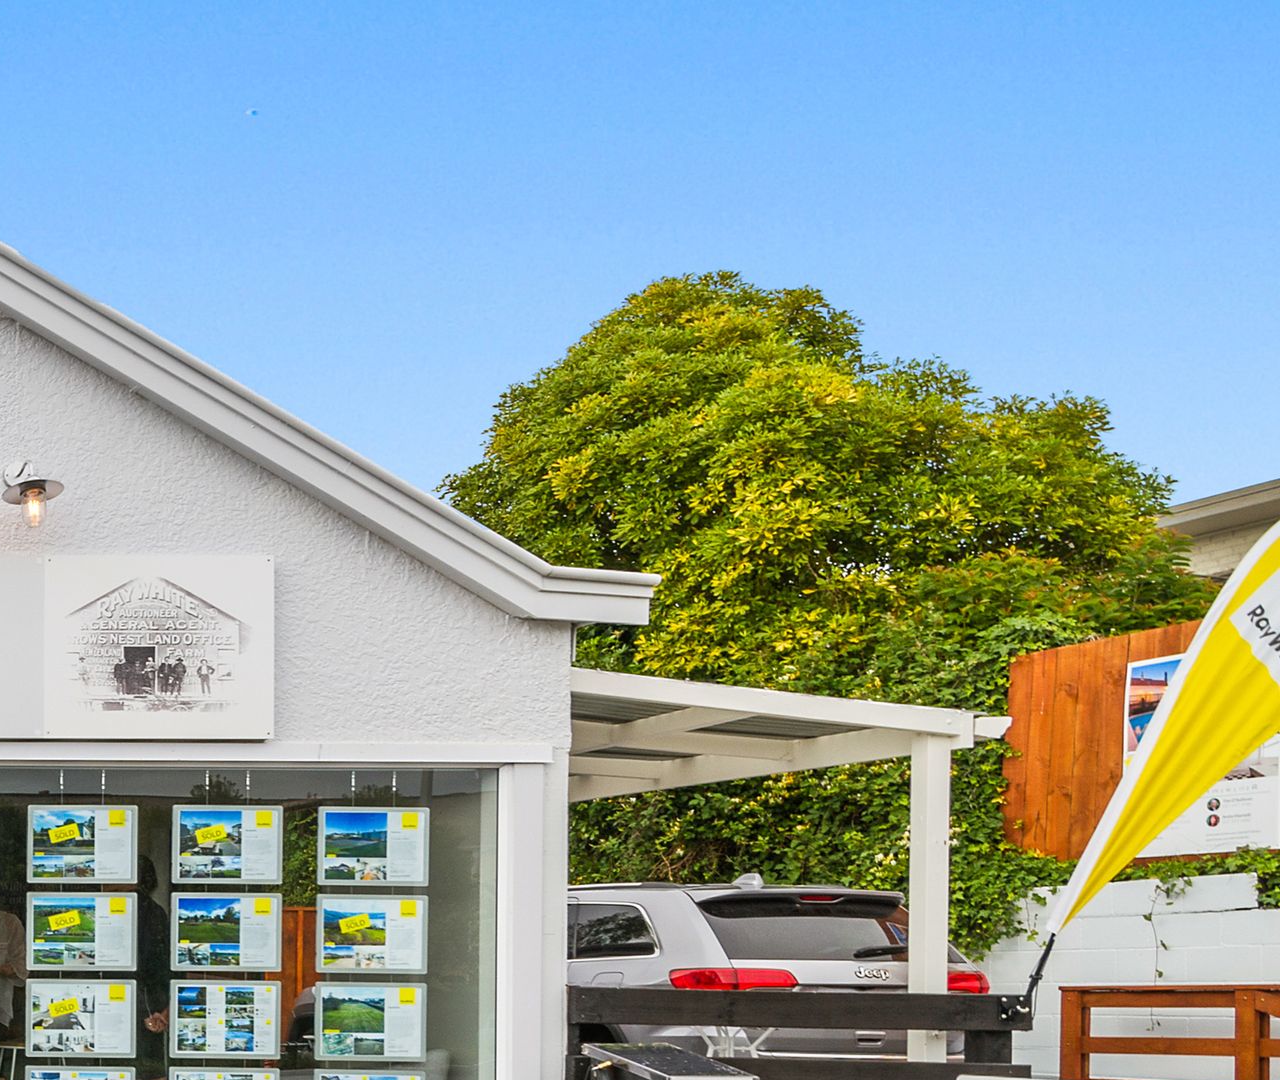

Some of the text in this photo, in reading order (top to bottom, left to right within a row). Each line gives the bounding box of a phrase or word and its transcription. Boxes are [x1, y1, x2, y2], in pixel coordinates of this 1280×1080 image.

[119, 608, 179, 619] AUCTIONEER
[90, 620, 159, 631] GENERAL
[110, 634, 143, 645] NEST
[146, 633, 181, 645] LAND
[54, 829, 75, 841] SOLD
[201, 830, 222, 841] SOLD
[54, 916, 75, 927] SOLD
[345, 919, 366, 930] SOLD
[855, 966, 889, 981] Jeep
[54, 1003, 75, 1014] SOLD
